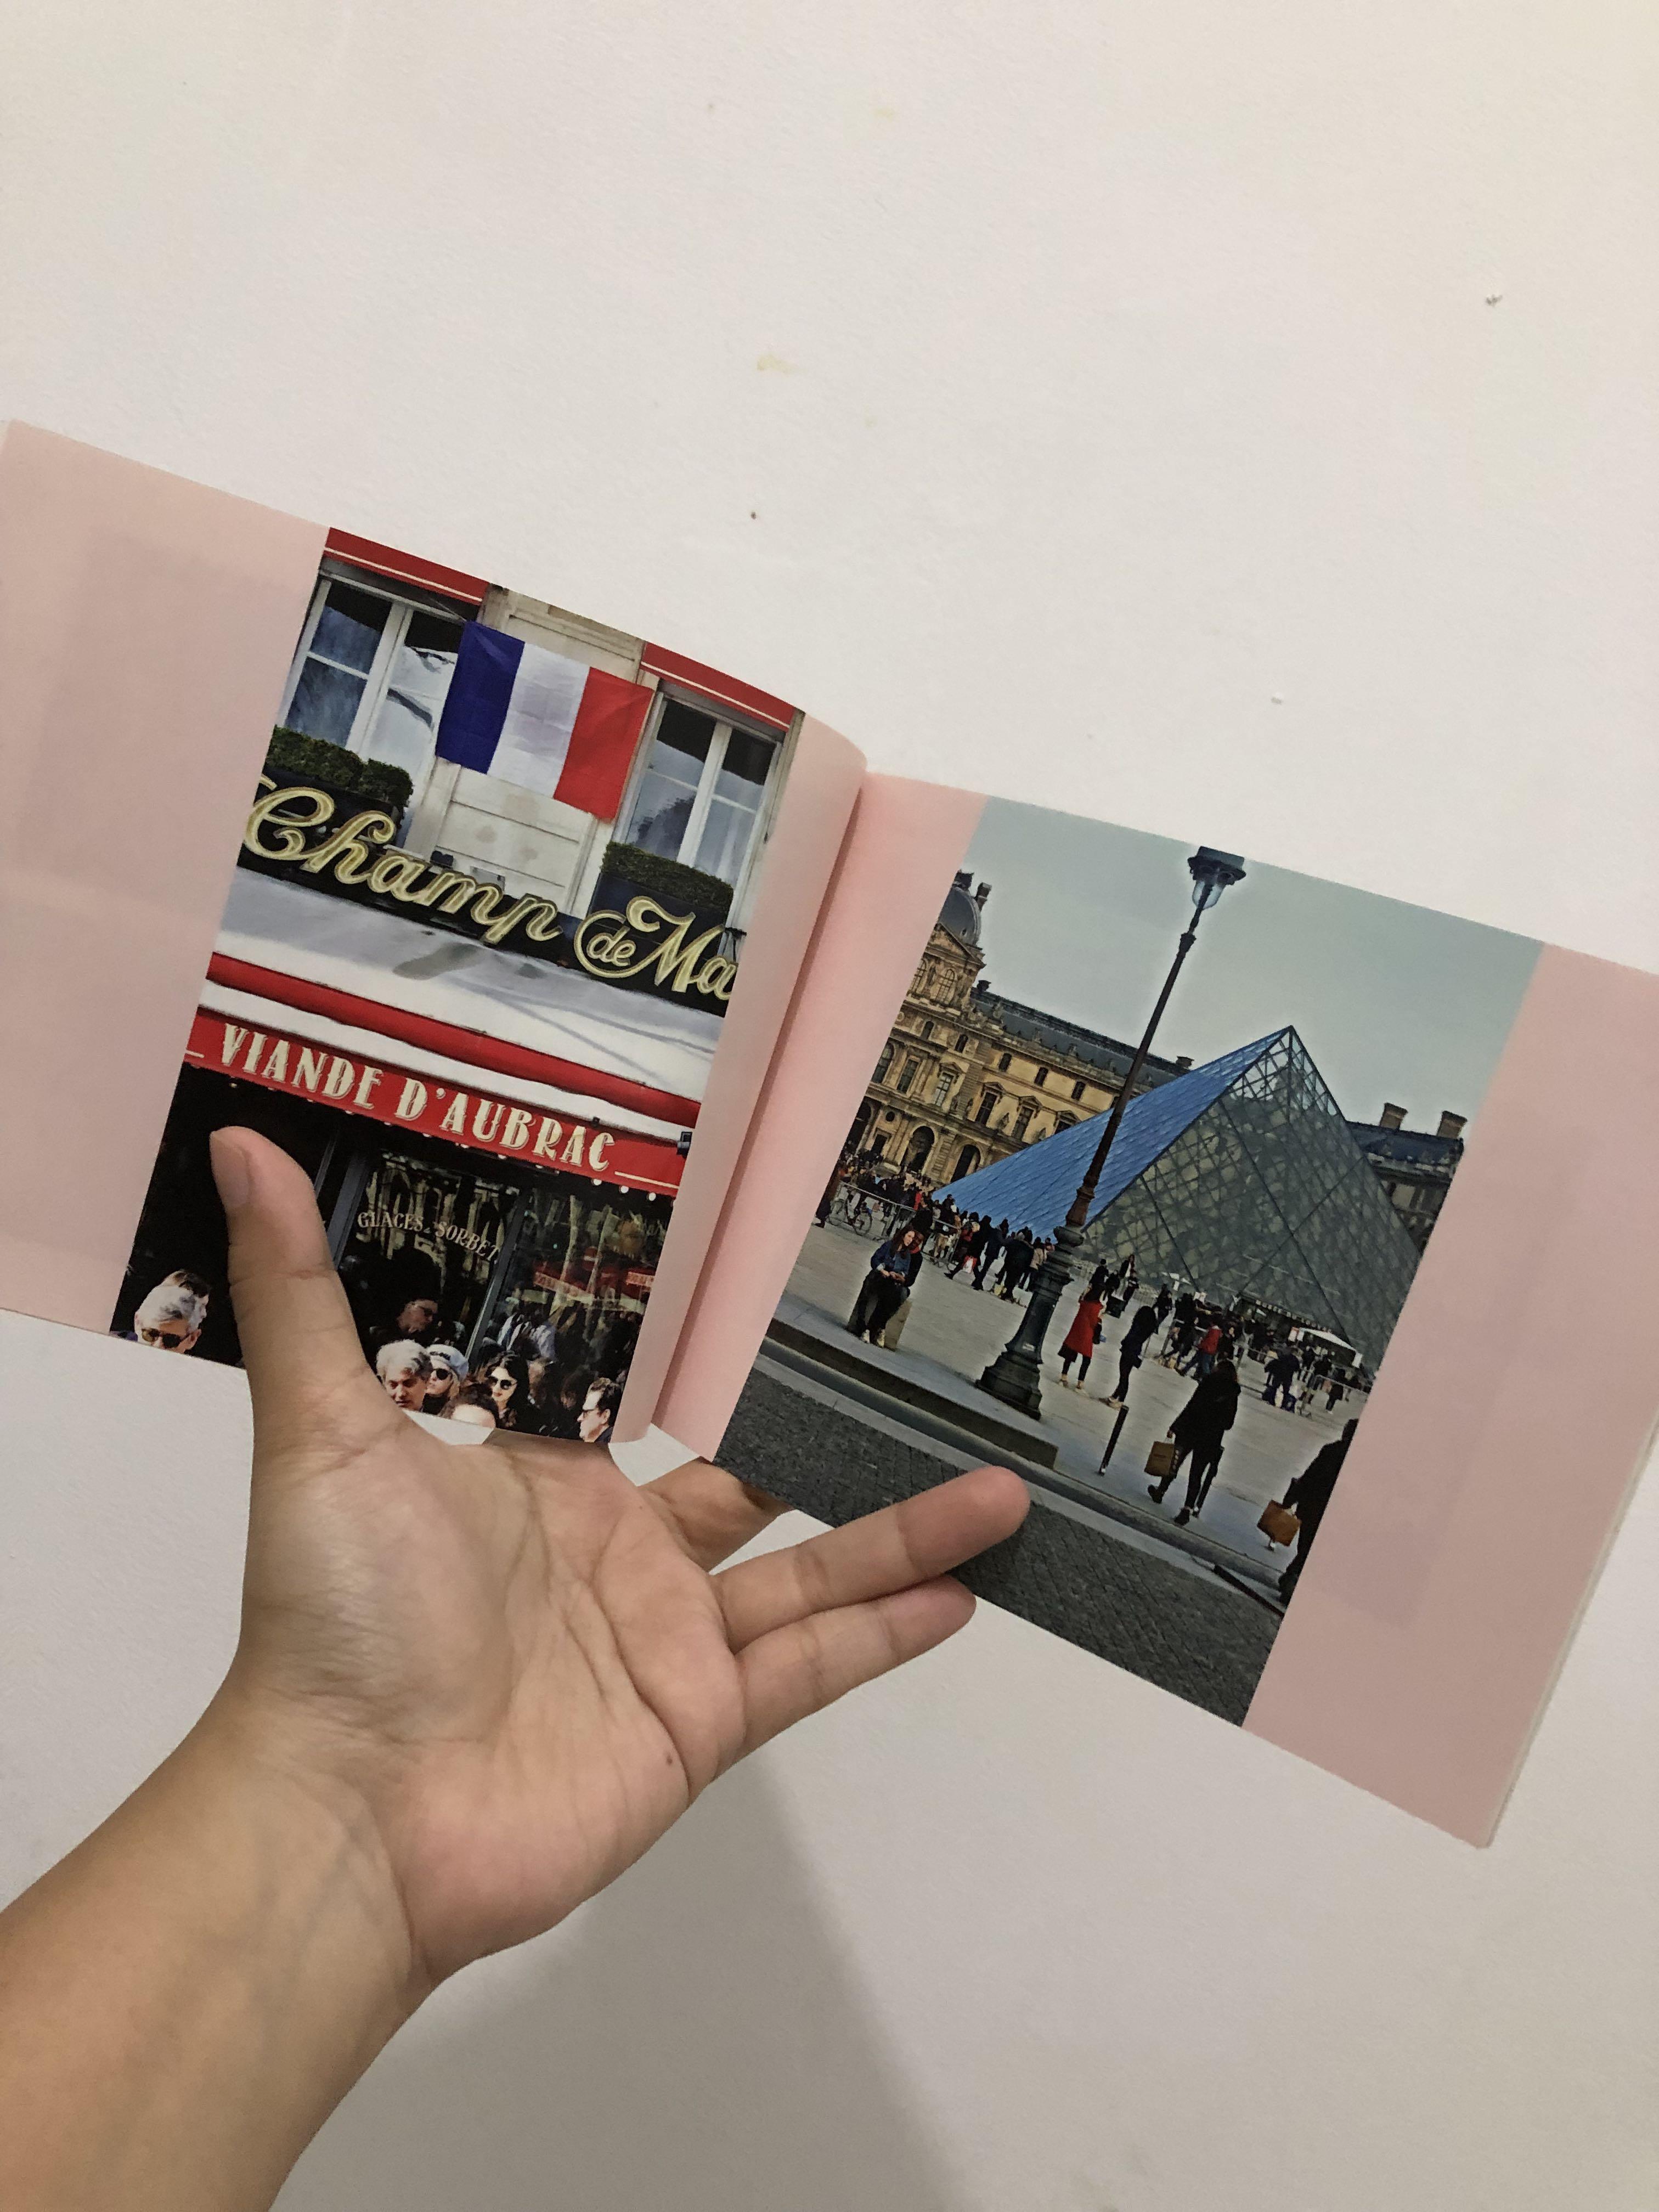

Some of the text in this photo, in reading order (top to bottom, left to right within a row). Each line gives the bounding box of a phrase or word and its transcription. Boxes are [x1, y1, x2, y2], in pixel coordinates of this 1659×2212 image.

[242, 781, 563, 945] Champ
[586, 924, 637, 967] de
[221, 1023, 616, 1171] VIANDE D'AUBRAC
[357, 1211, 424, 1232] GLACES
